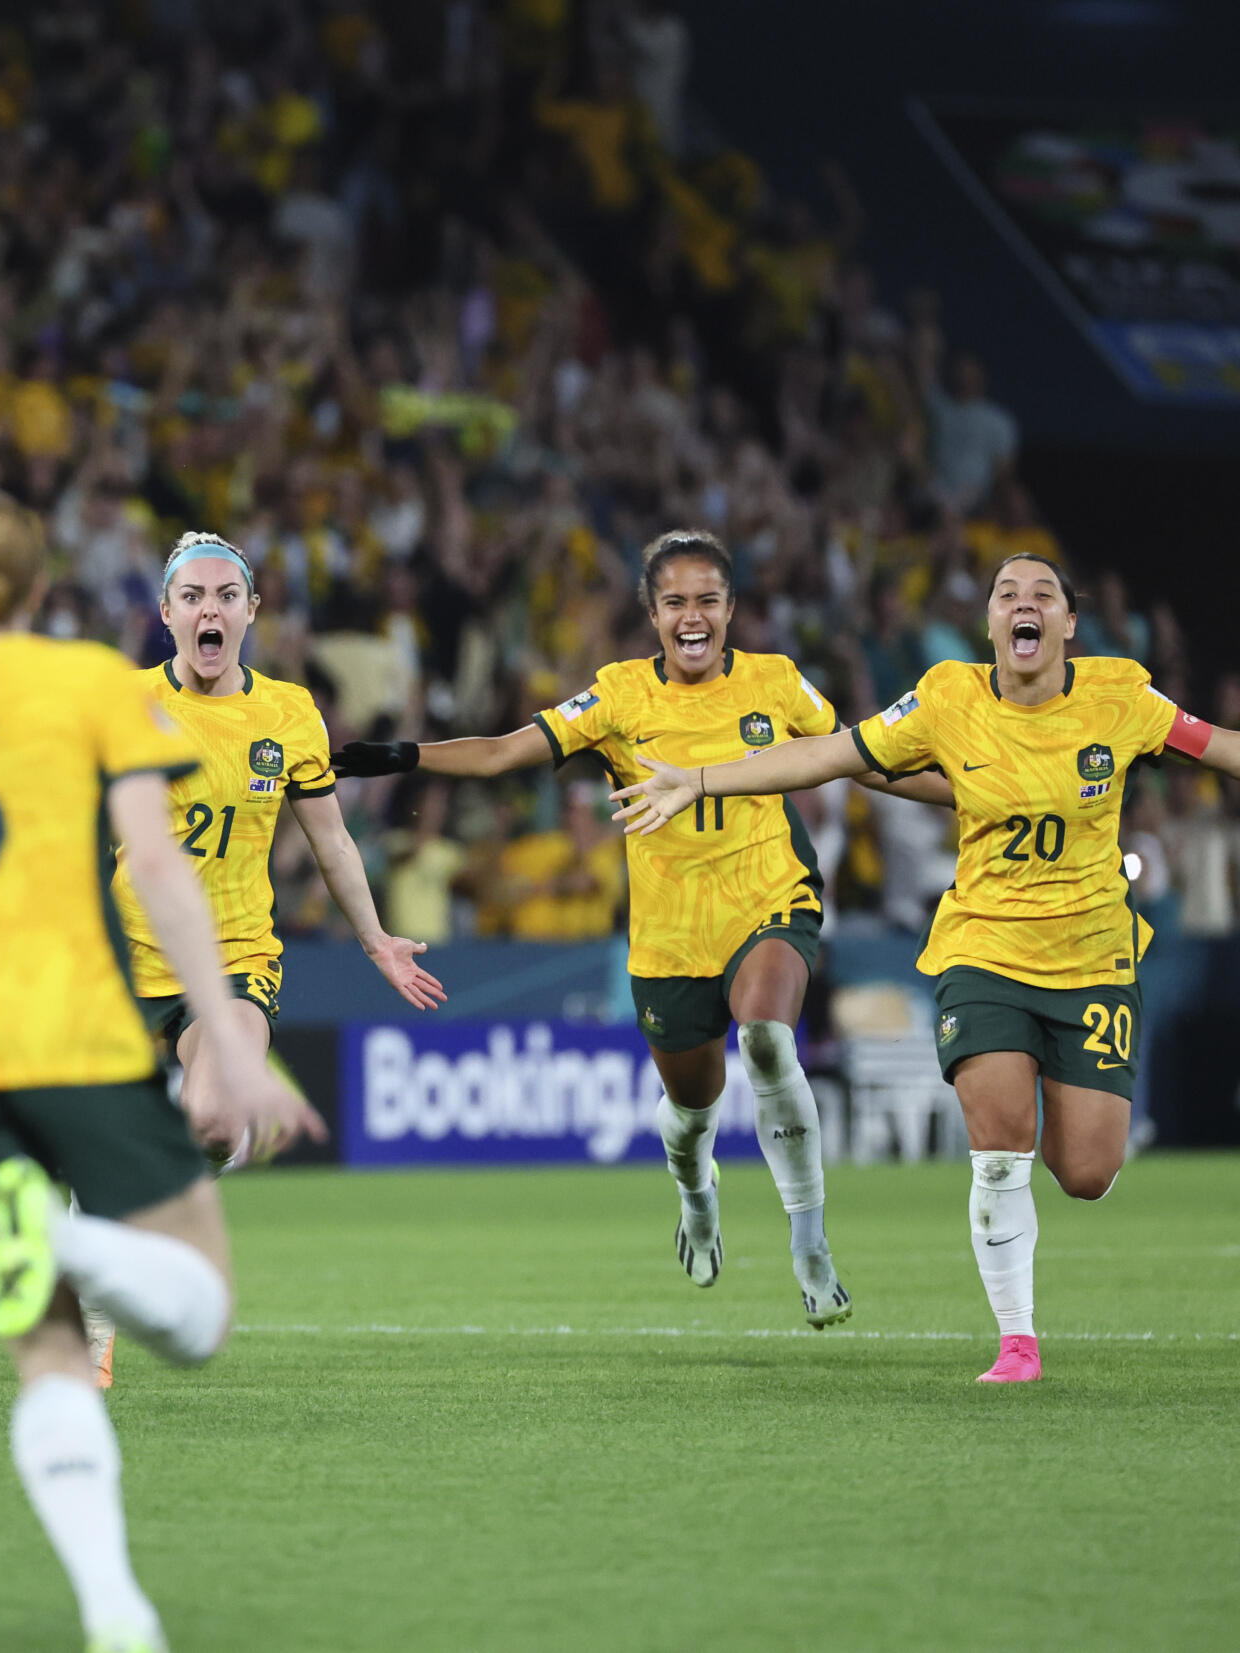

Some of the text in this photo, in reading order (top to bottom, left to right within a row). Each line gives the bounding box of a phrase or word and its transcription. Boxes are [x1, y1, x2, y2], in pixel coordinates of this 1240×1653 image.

[180, 803, 236, 858] 21
[695, 796, 723, 831] 11
[1002, 813, 1066, 862] 20
[1082, 1003, 1133, 1061] 20
[363, 1026, 755, 1161] Booking.m
